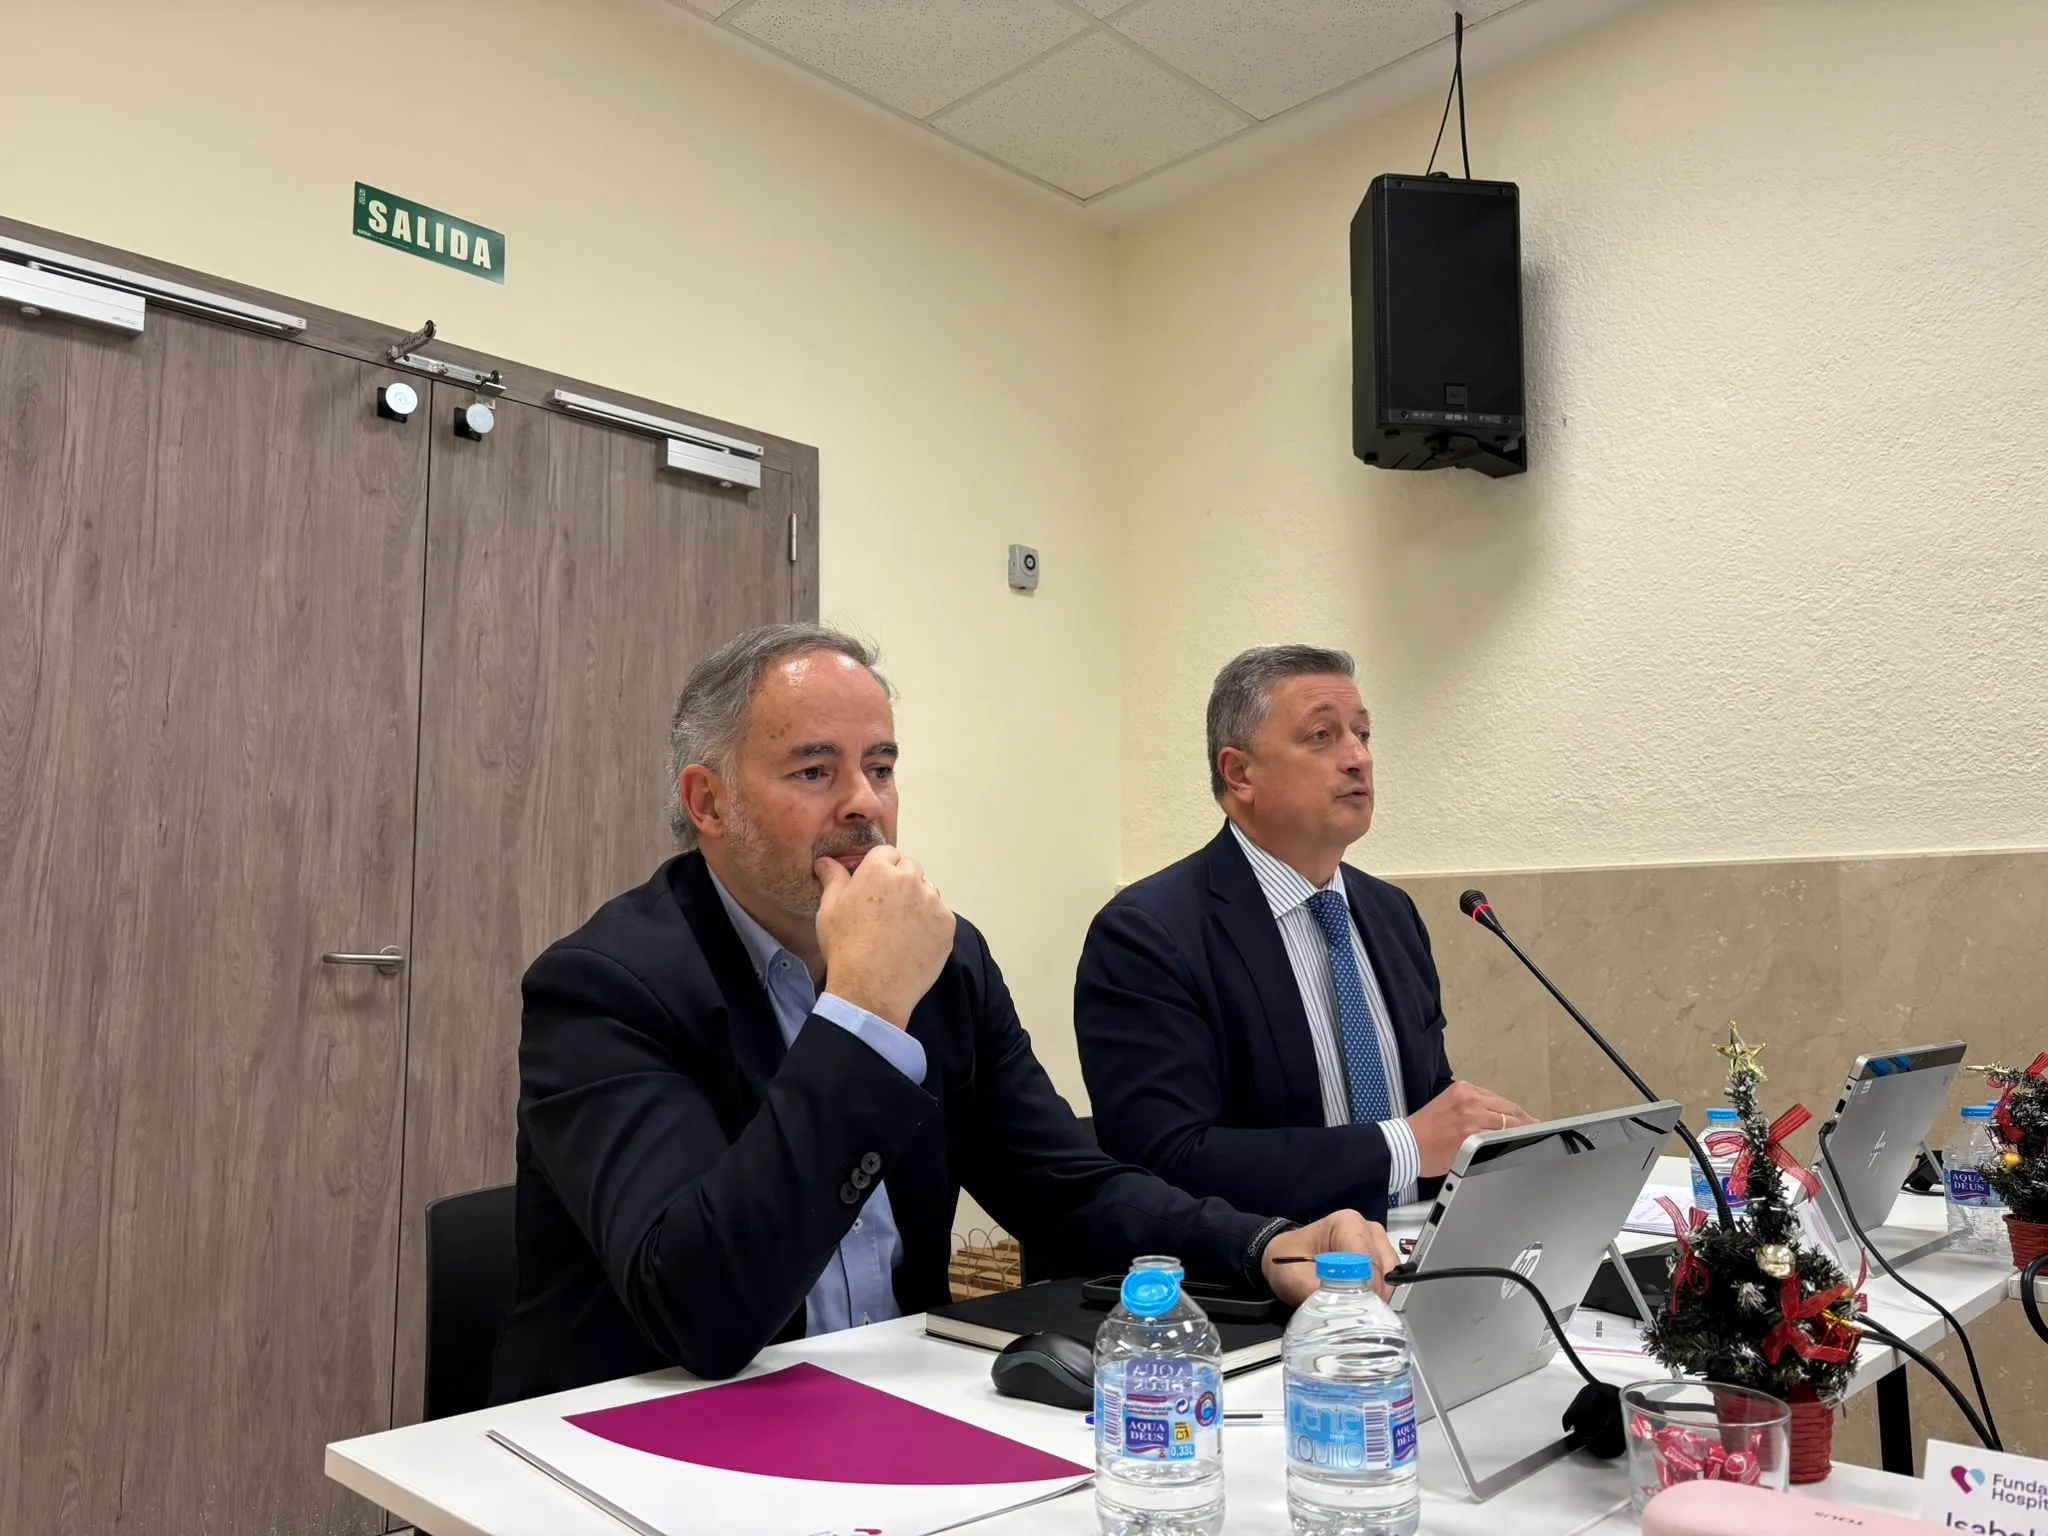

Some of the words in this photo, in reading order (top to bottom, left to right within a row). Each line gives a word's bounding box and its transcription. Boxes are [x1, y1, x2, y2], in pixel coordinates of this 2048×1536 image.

[368, 199, 492, 270] SALIDA
[1952, 1173, 1984, 1183] AQUA
[1953, 1182, 1985, 1192] DEUS
[1247, 1217, 1281, 1257] Speedmast
[1128, 1420, 1166, 1433] AQUA
[1129, 1430, 1165, 1443] DEUS
[1993, 1473, 2048, 1496] Funda
[1992, 1487, 2048, 1511] Hospit
[1946, 1511, 2034, 1536] Isab
